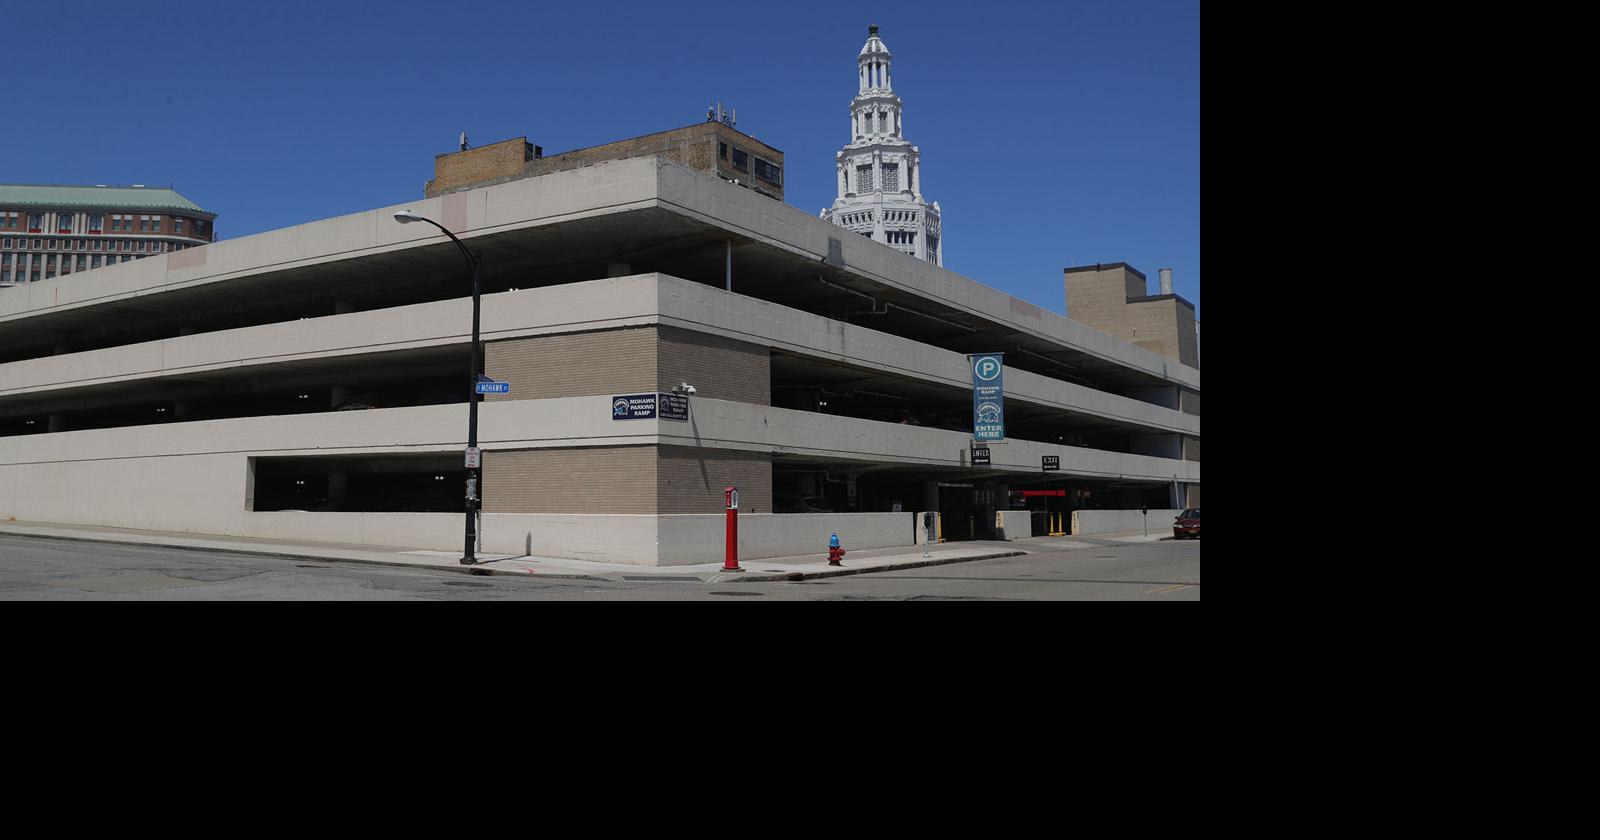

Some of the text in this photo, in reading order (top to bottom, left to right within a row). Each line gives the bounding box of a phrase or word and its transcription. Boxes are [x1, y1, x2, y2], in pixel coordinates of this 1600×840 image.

[983, 362, 994, 376] P
[481, 384, 503, 392] MOHAWK
[1043, 456, 1058, 464] EXIT
